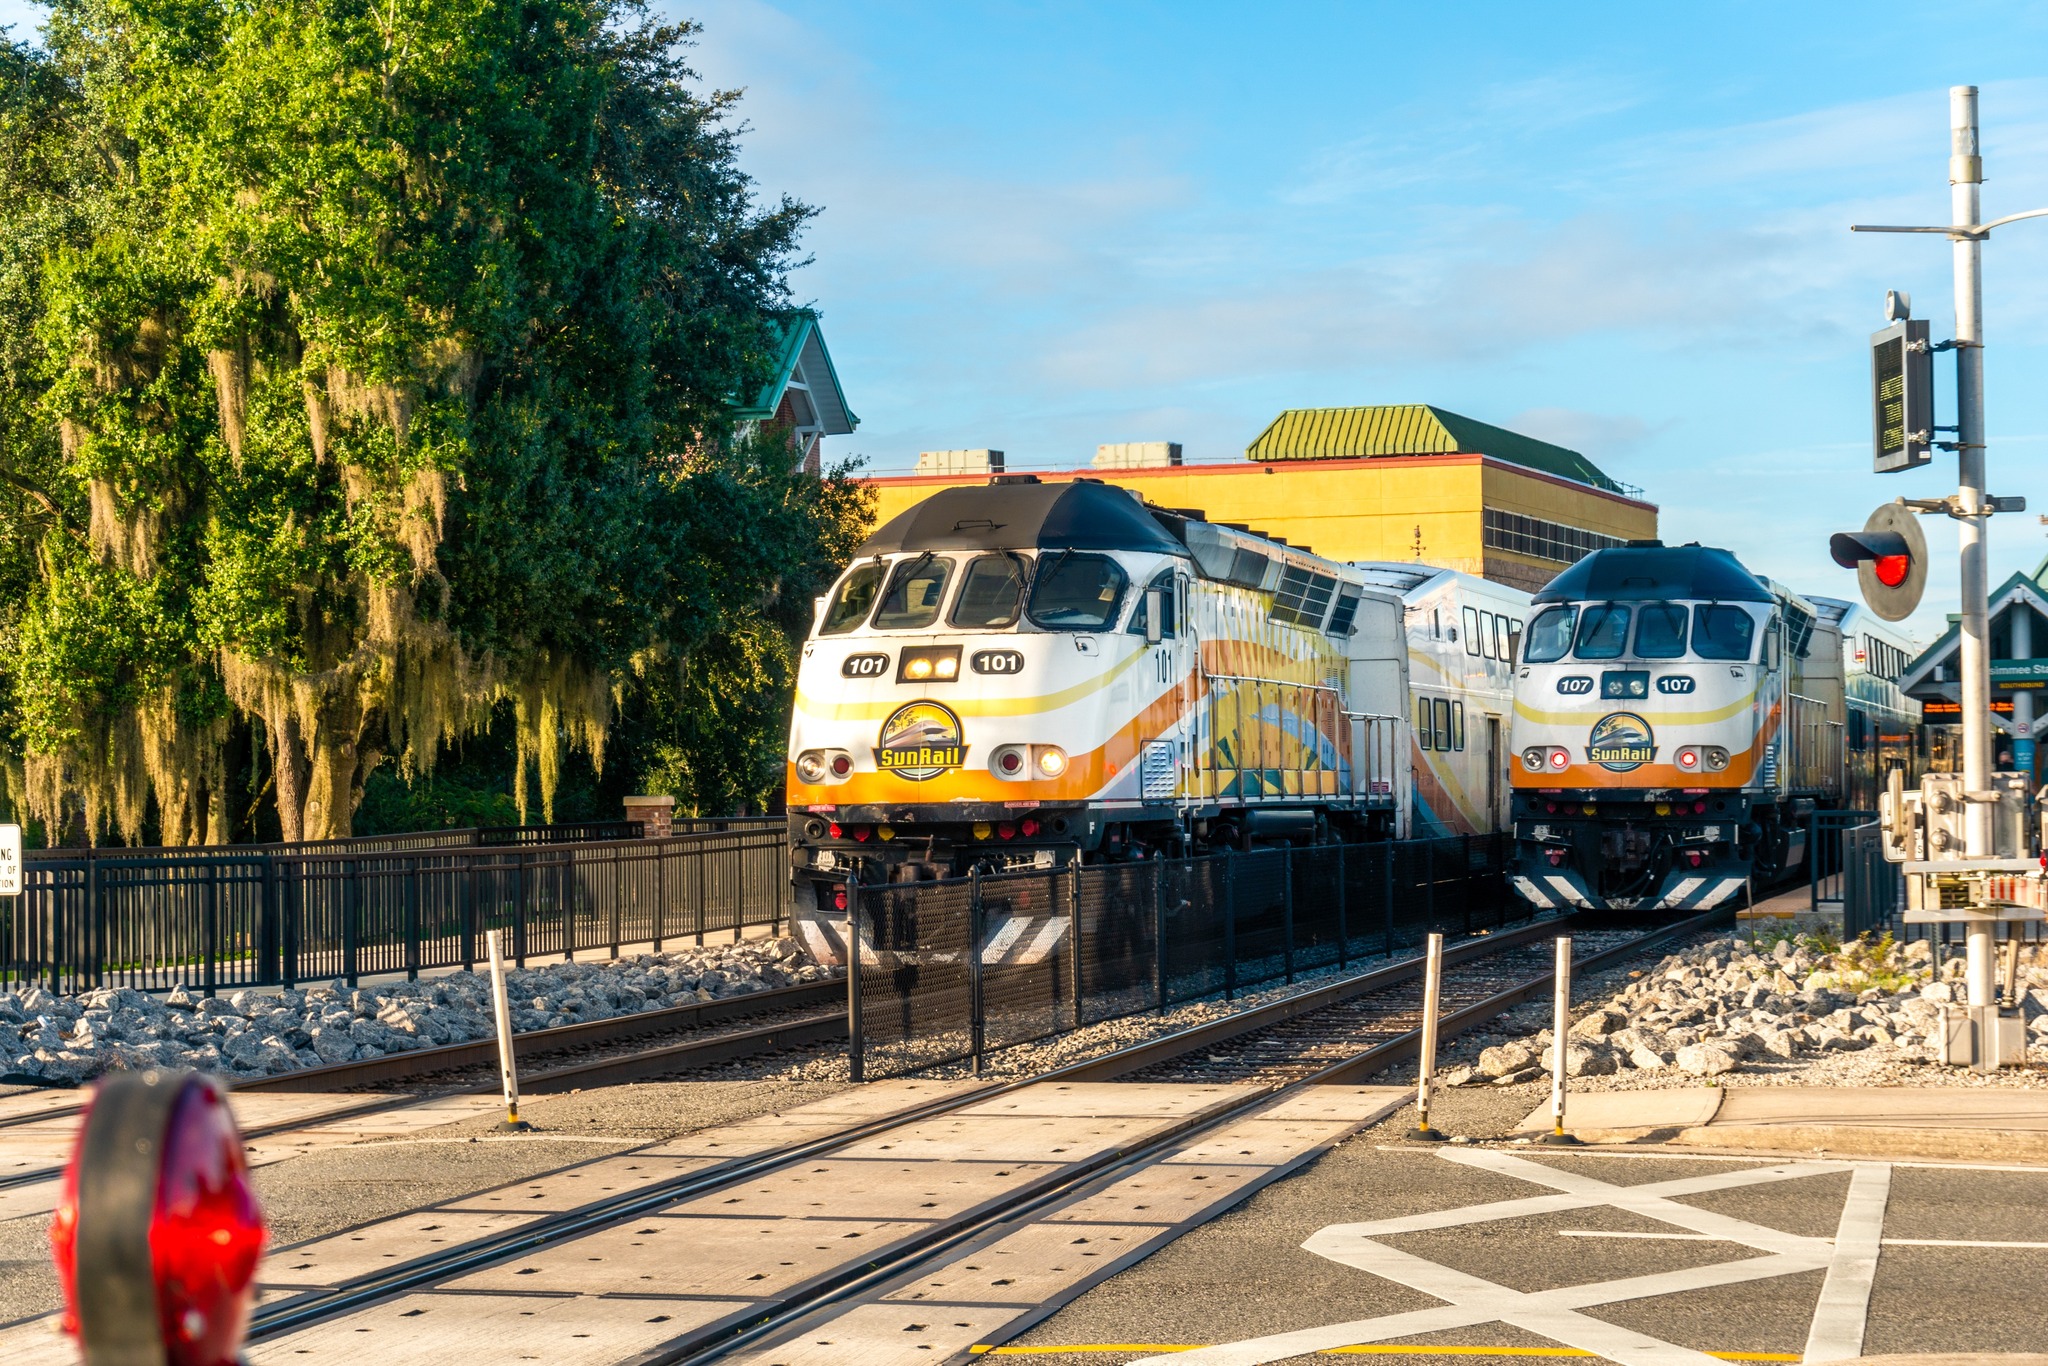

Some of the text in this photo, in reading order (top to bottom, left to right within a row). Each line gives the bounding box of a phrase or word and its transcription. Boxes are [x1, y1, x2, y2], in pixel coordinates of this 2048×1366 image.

[850, 658, 884, 674] 101
[980, 655, 1017, 671] 101
[1155, 649, 1172, 683] 101
[1989, 666, 2031, 675] simmee
[1561, 680, 1591, 691] 107
[1661, 679, 1691, 691] 107
[881, 747, 959, 766] SunRail
[1591, 747, 1651, 760] SunRail
[1089, 822, 1095, 834] F
[7, 865, 16, 874] OF
[0, 879, 14, 888] ION
